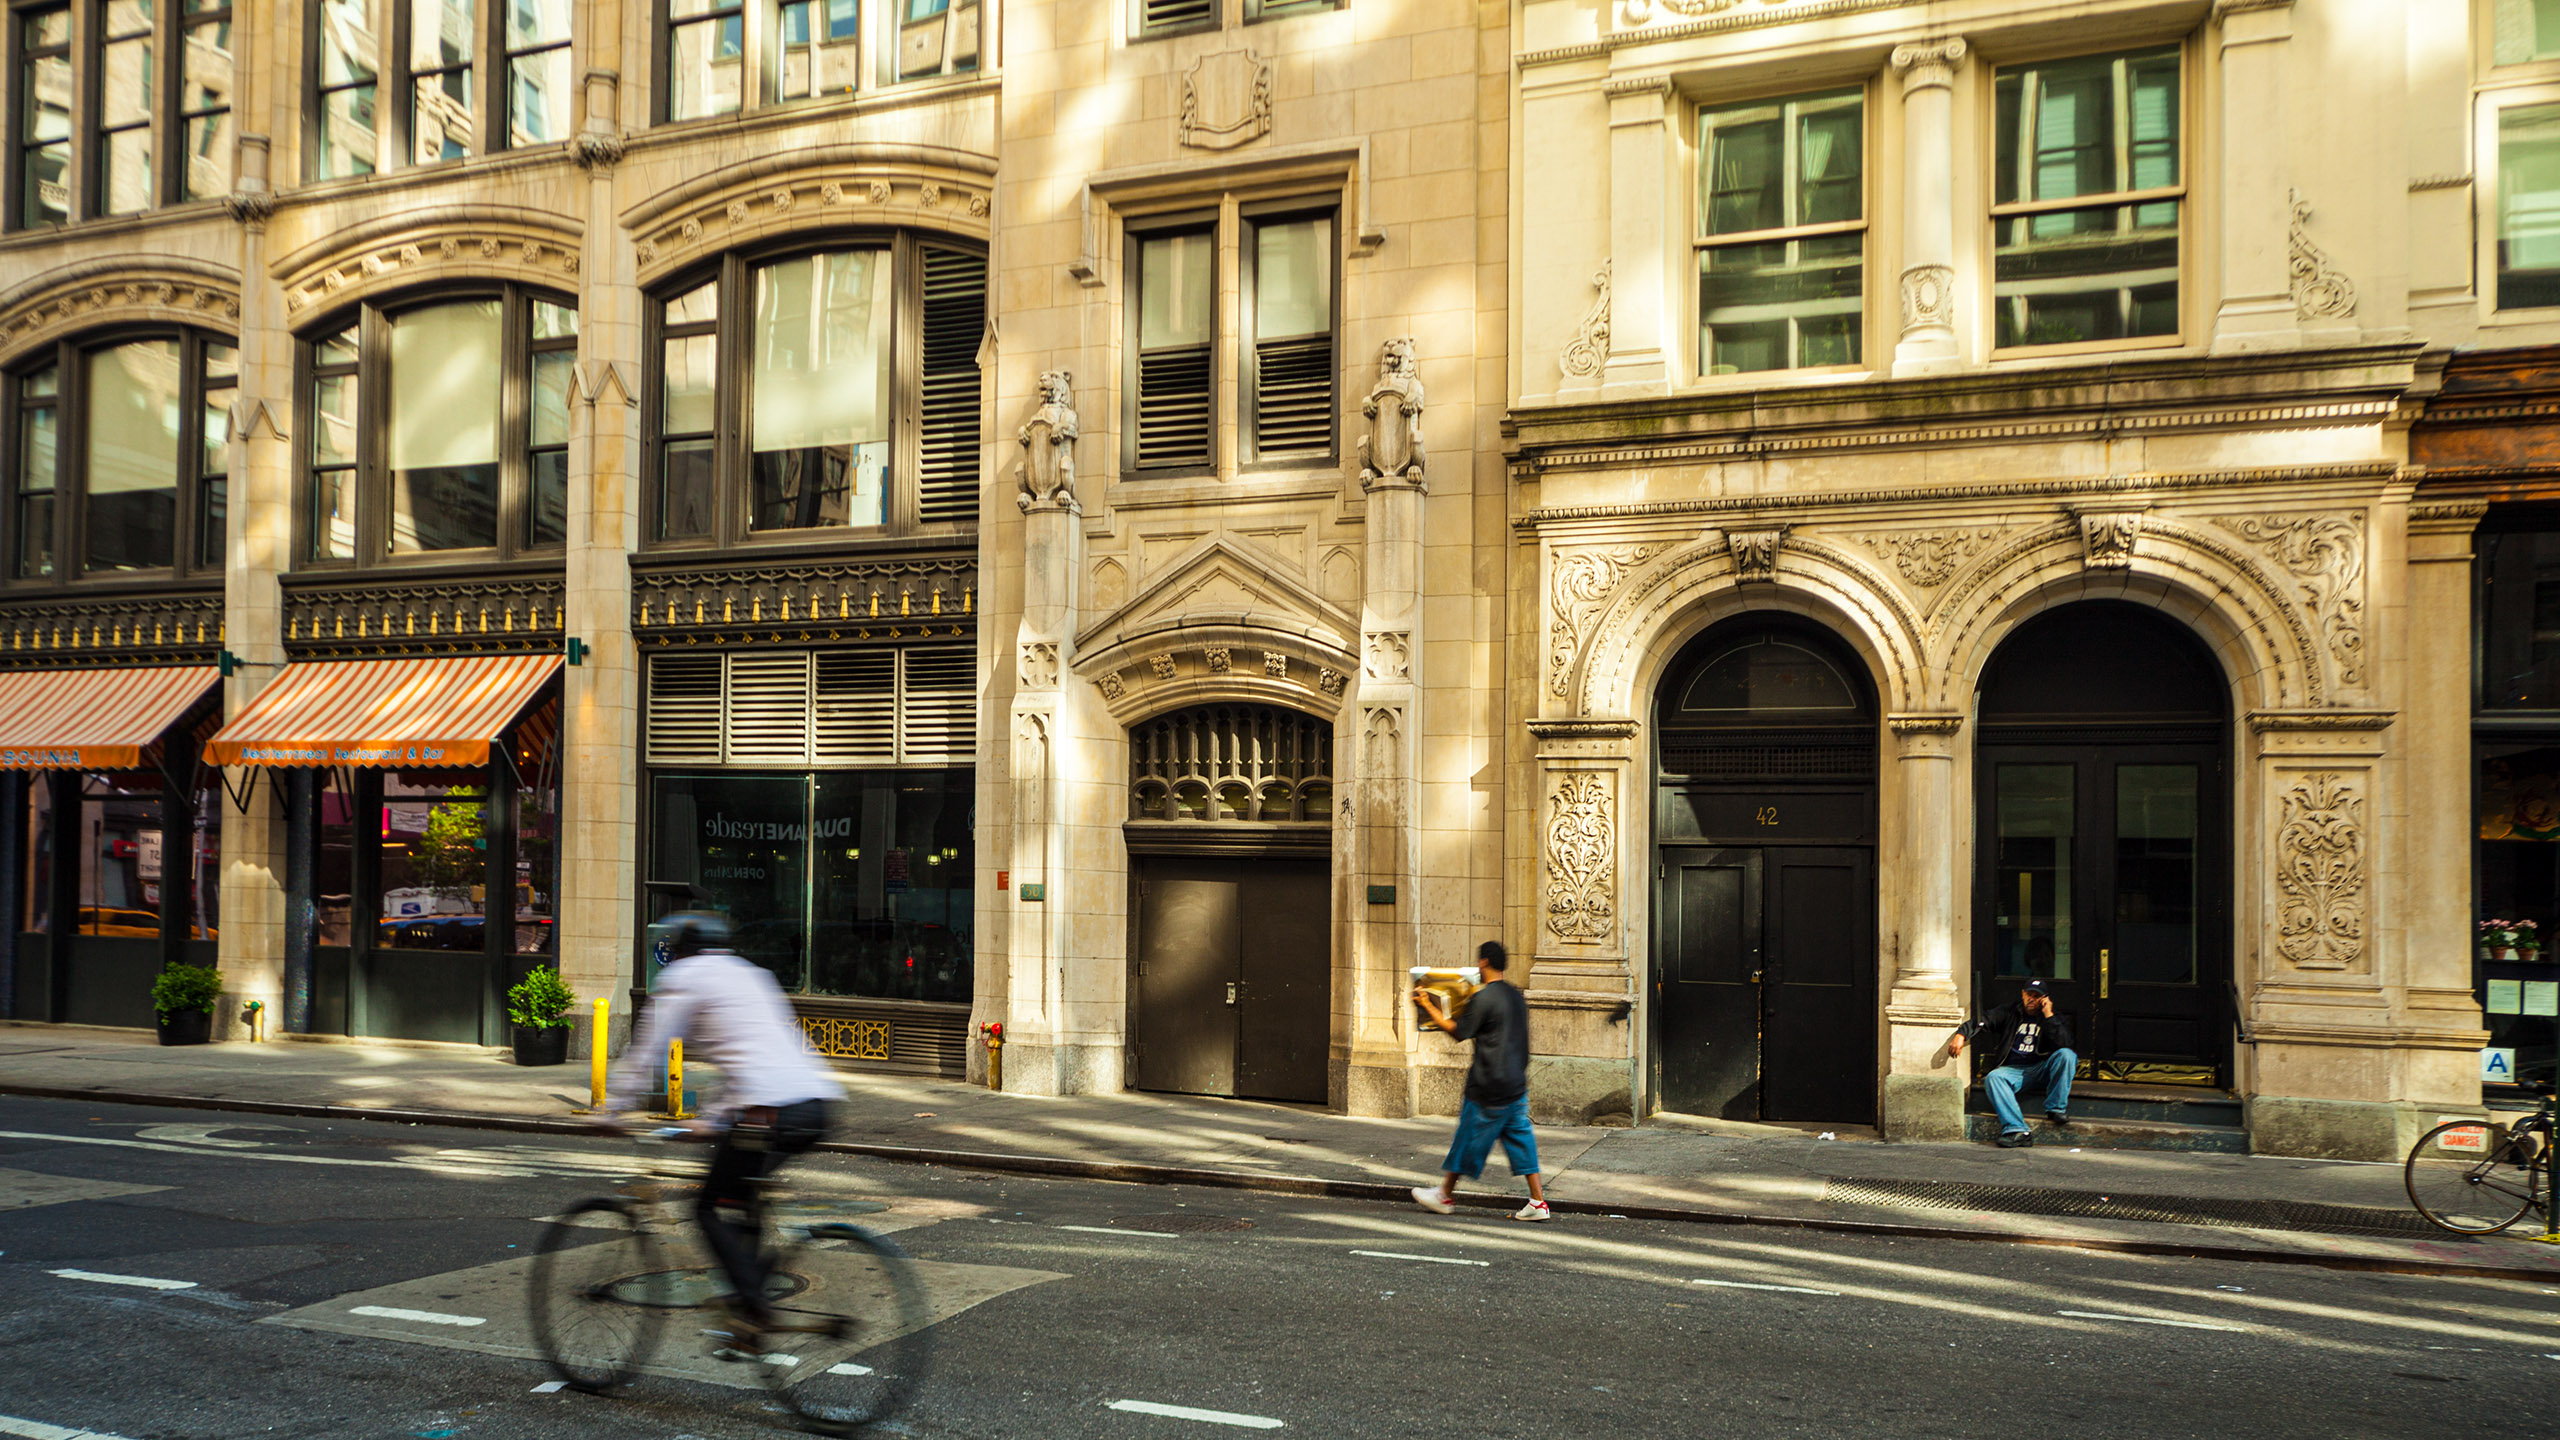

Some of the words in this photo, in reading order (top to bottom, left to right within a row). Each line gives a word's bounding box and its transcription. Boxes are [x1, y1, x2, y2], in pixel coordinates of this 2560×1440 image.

[241, 746, 329, 760] Mediterranean
[334, 747, 403, 760] Restaurant
[407, 746, 417, 760] &
[422, 746, 445, 760] Bar
[1756, 806, 1779, 826] 42
[1025, 886, 1040, 898] 50
[1373, 887, 1391, 901] 50
[2487, 1053, 2508, 1073] A
[2443, 1134, 2481, 1147] SIAMESE
